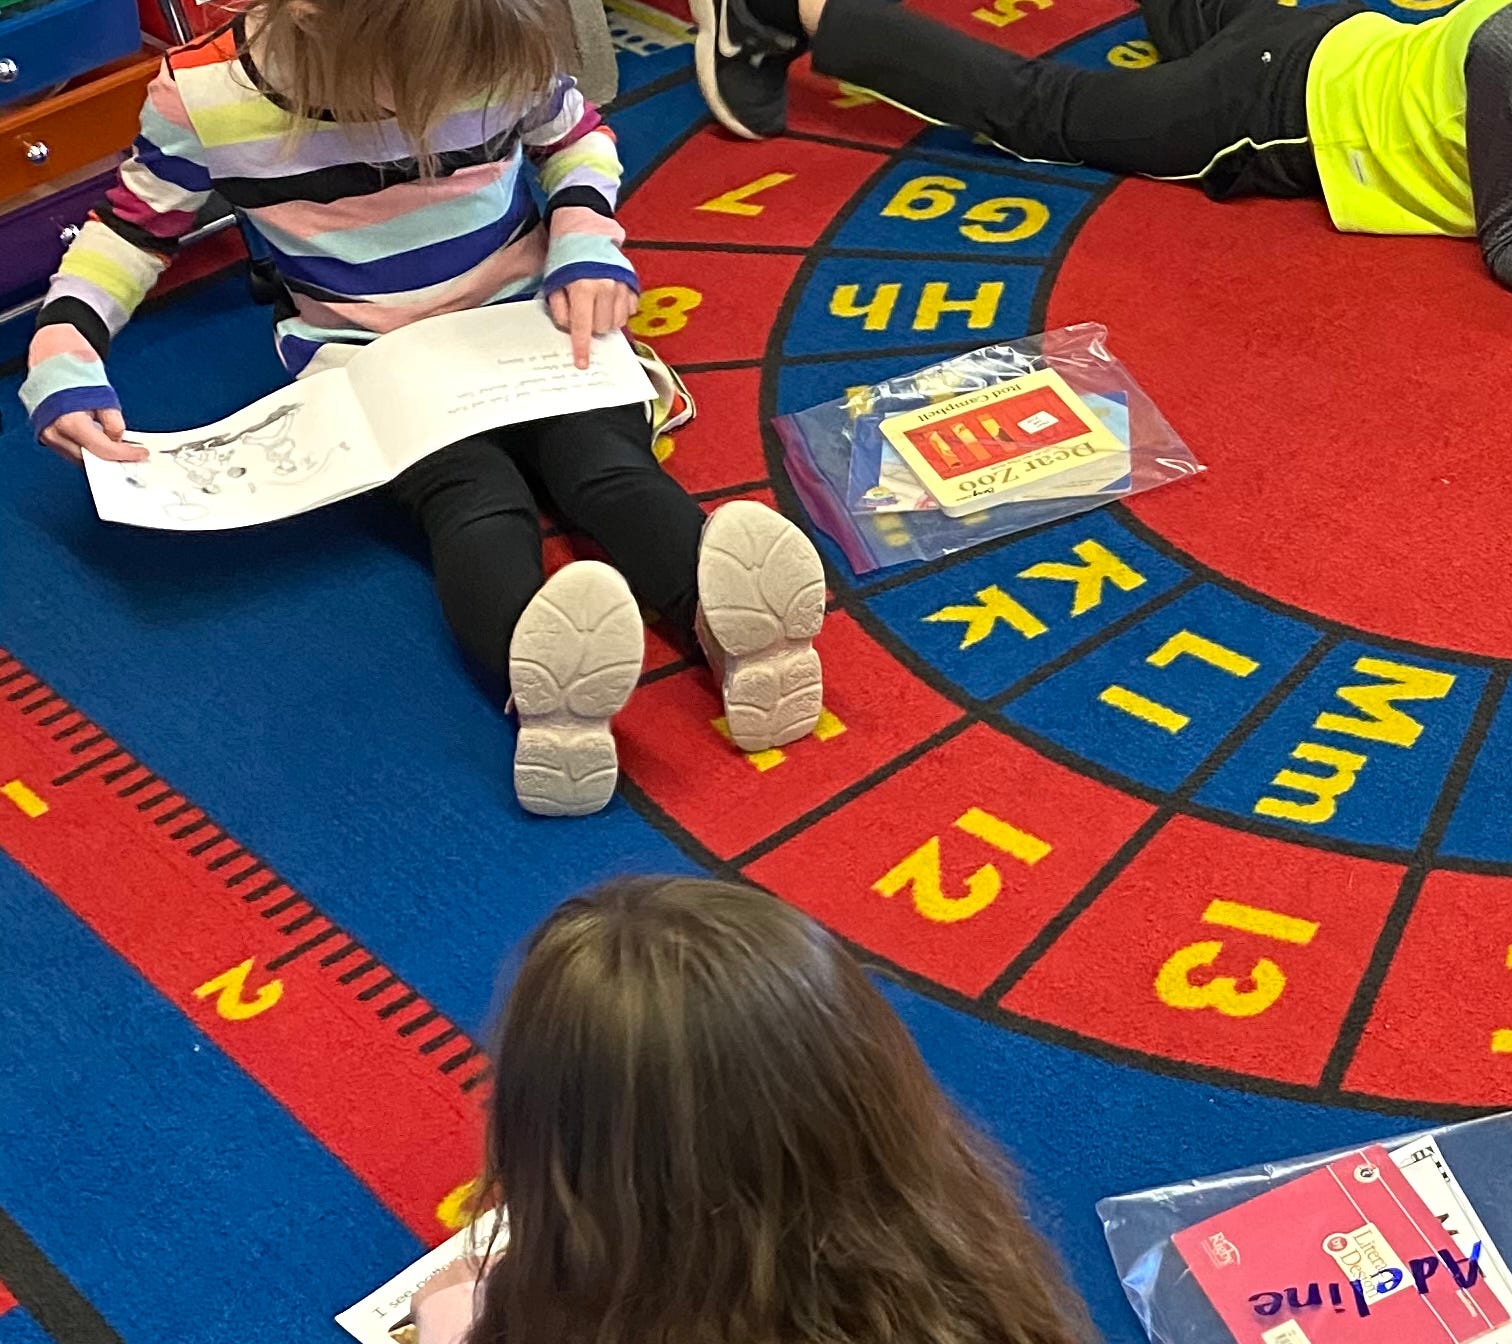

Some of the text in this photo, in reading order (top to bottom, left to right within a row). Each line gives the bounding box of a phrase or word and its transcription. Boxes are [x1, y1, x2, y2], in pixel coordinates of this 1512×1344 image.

[694, 171, 796, 217] 7
[881, 175, 1051, 244] Gg
[627, 285, 703, 338] 8
[829, 281, 1005, 331] Hh
[917, 384, 1022, 423] Rod Campbell
[958, 464, 1020, 492] Zoo
[1023, 441, 1097, 473] Dear
[923, 539, 1147, 650] Kk
[1099, 629, 1260, 734] Ll
[1253, 656, 1457, 824] Mm
[871, 806, 1054, 923] 12
[1154, 899, 1321, 1018] 13
[193, 957, 284, 1020] 2
[1207, 1231, 1239, 1267] Rigby
[373, 1306, 388, 1318] I
[389, 1289, 412, 1309] see
[1247, 1239, 1487, 1318] Adeline
